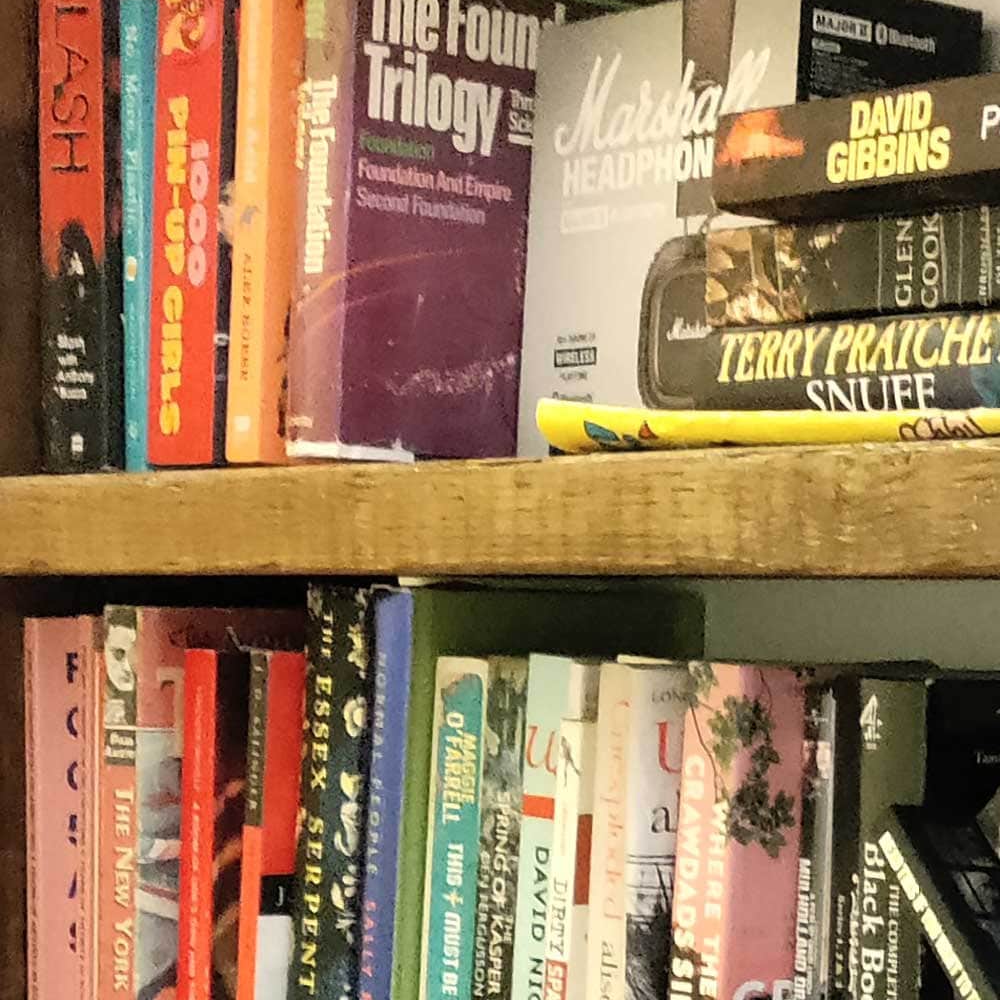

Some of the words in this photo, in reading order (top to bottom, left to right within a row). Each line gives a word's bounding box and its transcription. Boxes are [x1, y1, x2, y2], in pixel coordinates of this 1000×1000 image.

[363, 41, 503, 158] Trilogy
[554, 46, 771, 156] Marshall
[850, 90, 933, 140] DAVID
[164, 95, 190, 276] PIN-UP
[357, 156, 435, 190] Foundation
[436, 170, 466, 196] And
[464, 173, 514, 204] Empire
[825, 125, 952, 184] GIBBINS
[187, 138, 210, 287] 1000
[304, 126, 336, 273] Foundation
[355, 185, 411, 216] Second
[411, 194, 488, 225] Foundation
[894, 219, 914, 308] GLEN
[920, 203, 940, 309] COOK
[159, 284, 185, 436] GIRLS
[716, 325, 833, 383] TERRY
[805, 371, 936, 413] SNUFF
[320, 610, 334, 659] THE
[310, 674, 333, 791] ESSEX
[371, 651, 388, 763] NORMAL
[441, 711, 465, 825] O'FARRELL
[460, 732, 478, 805] MAGGIE
[114, 786, 136, 840] THE
[366, 777, 385, 876] PEOPLE
[492, 791, 513, 875] SPRING
[112, 848, 136, 910] NEW
[446, 842, 465, 887] THIS
[479, 850, 491, 889] BEN
[491, 876, 507, 910] OF
[530, 845, 550, 942] DAVID
[672, 755, 705, 952] CRAWDADS
[704, 799, 731, 919] WHERE
[861, 841, 886, 936] Black
[299, 814, 326, 996] SERPENT
[361, 900, 377, 978] SALLY
[503, 910, 514, 945] THE
[549, 877, 568, 957] DIRTY
[794, 857, 812, 972] MULHOLLAND
[888, 883, 900, 917] THE
[112, 922, 138, 992] YORK
[442, 911, 462, 970] MUST
[474, 893, 490, 998] FERGUSSON
[487, 914, 506, 995] KASPER
[699, 934, 721, 997] THE
[442, 971, 460, 997] BE
